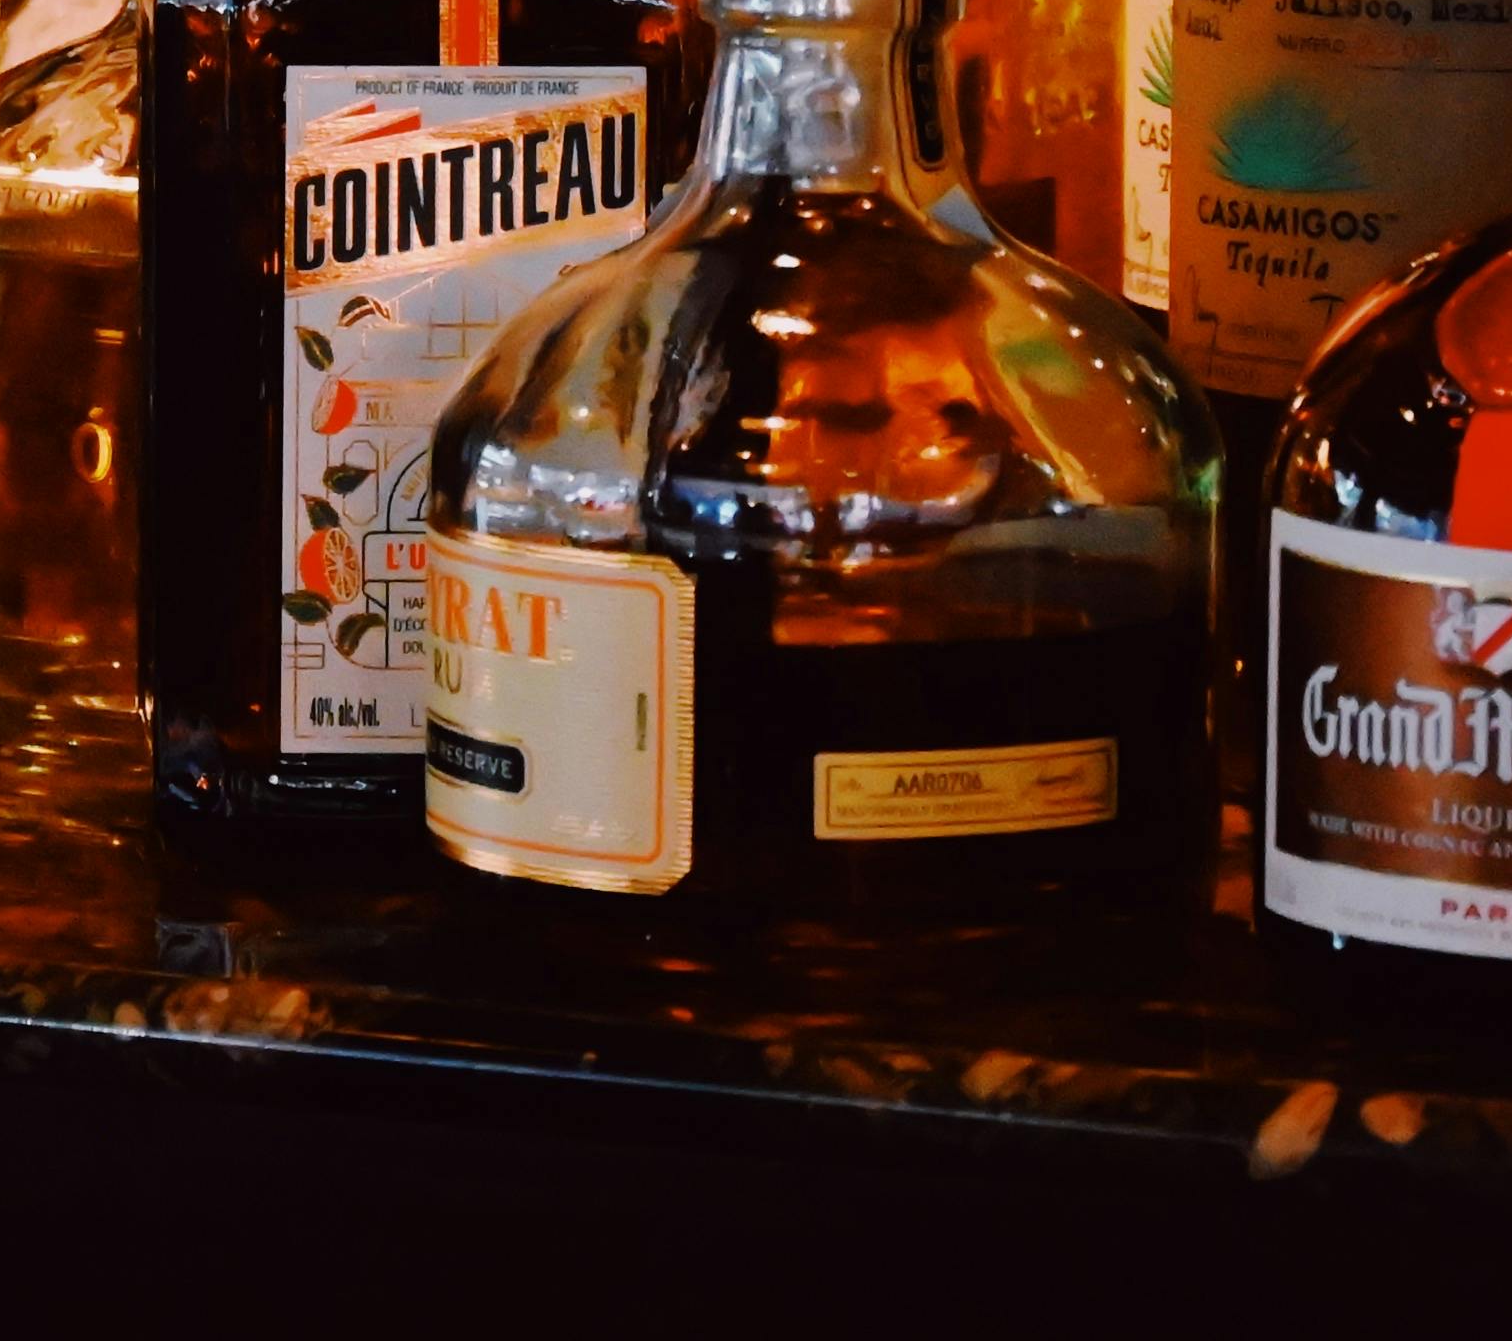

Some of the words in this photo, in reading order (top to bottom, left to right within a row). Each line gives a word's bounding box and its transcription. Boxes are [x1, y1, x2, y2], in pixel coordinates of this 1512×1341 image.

[355, 80, 402, 96] PRODUCT
[407, 80, 419, 95] OF
[423, 80, 464, 95] FRANCE
[473, 80, 517, 95] PRODUIT
[520, 80, 535, 95] DE
[537, 80, 580, 95] FRANCE
[1138, 118, 1170, 151] CAS
[293, 112, 636, 271] COINTREAU
[1197, 193, 1381, 243] CASAMIGOS
[1227, 240, 1330, 287] Tequila
[309, 697, 334, 727] 40%
[1302, 663, 1456, 776] Grand
[439, 742, 513, 780] RESERVE
[1352, 820, 1396, 844] WITH
[1400, 829, 1483, 858] COGNAC
